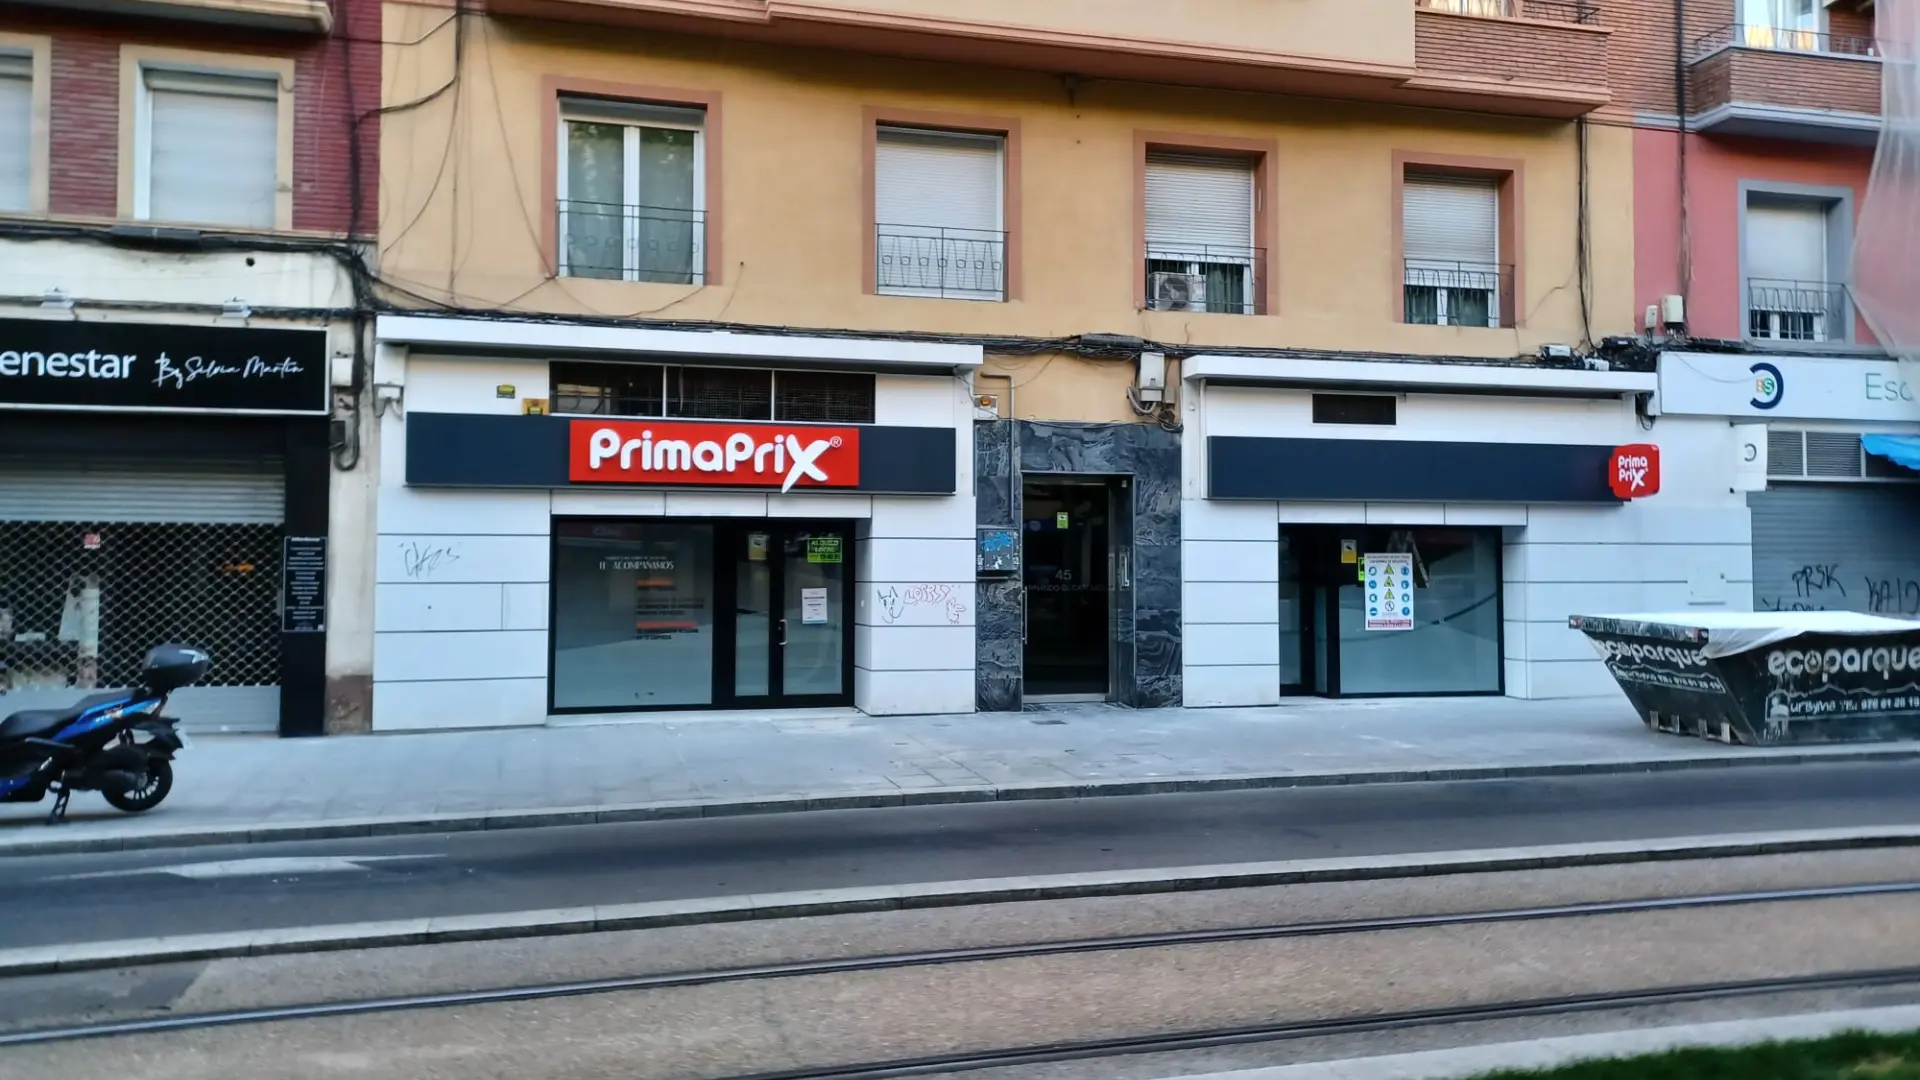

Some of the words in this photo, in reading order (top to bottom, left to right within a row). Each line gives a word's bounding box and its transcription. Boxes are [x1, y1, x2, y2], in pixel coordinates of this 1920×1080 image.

[0, 349, 137, 379] enestar
[150, 351, 183, 390] By
[1618, 454, 1648, 469] Prima
[1055, 569, 1073, 581] 45
